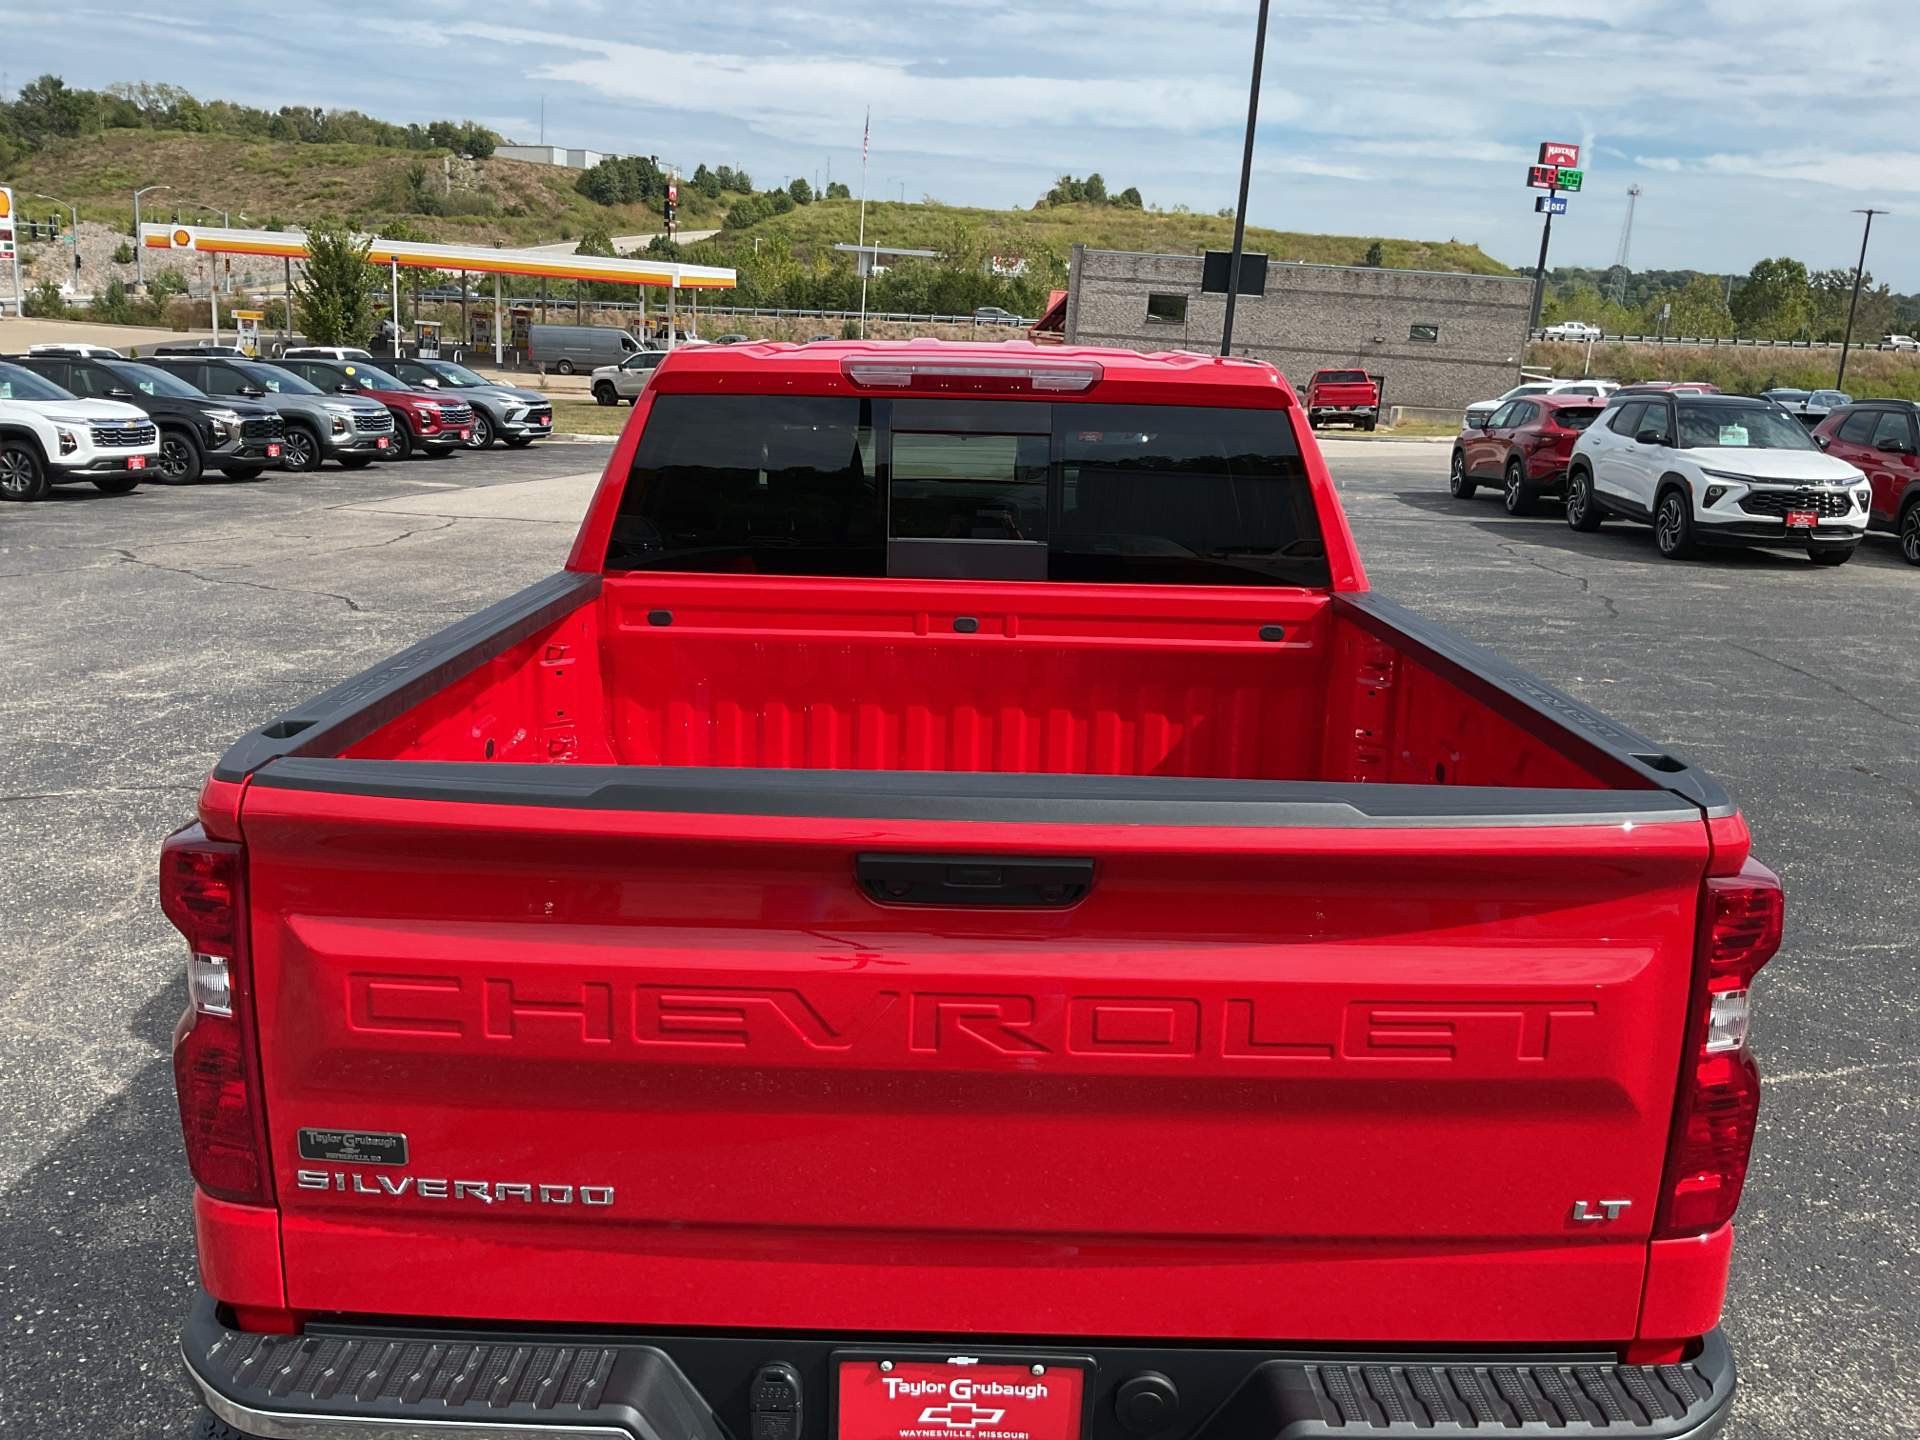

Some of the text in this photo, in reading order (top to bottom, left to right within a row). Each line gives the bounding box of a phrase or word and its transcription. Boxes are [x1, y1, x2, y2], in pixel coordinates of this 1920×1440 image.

[1547, 146, 1576, 160] MAVERIK
[1551, 203, 1565, 212] DEF
[345, 971, 1598, 1062] CHEVROLET
[306, 1131, 396, 1148] Taylor Grubaugh
[297, 1169, 615, 1205] SILVERADO
[1573, 1200, 1632, 1219] LT
[882, 1377, 1048, 1400] Taylor Grubaugh
[899, 1429, 1029, 1440] WAYNESVILLE, MISSOURI
